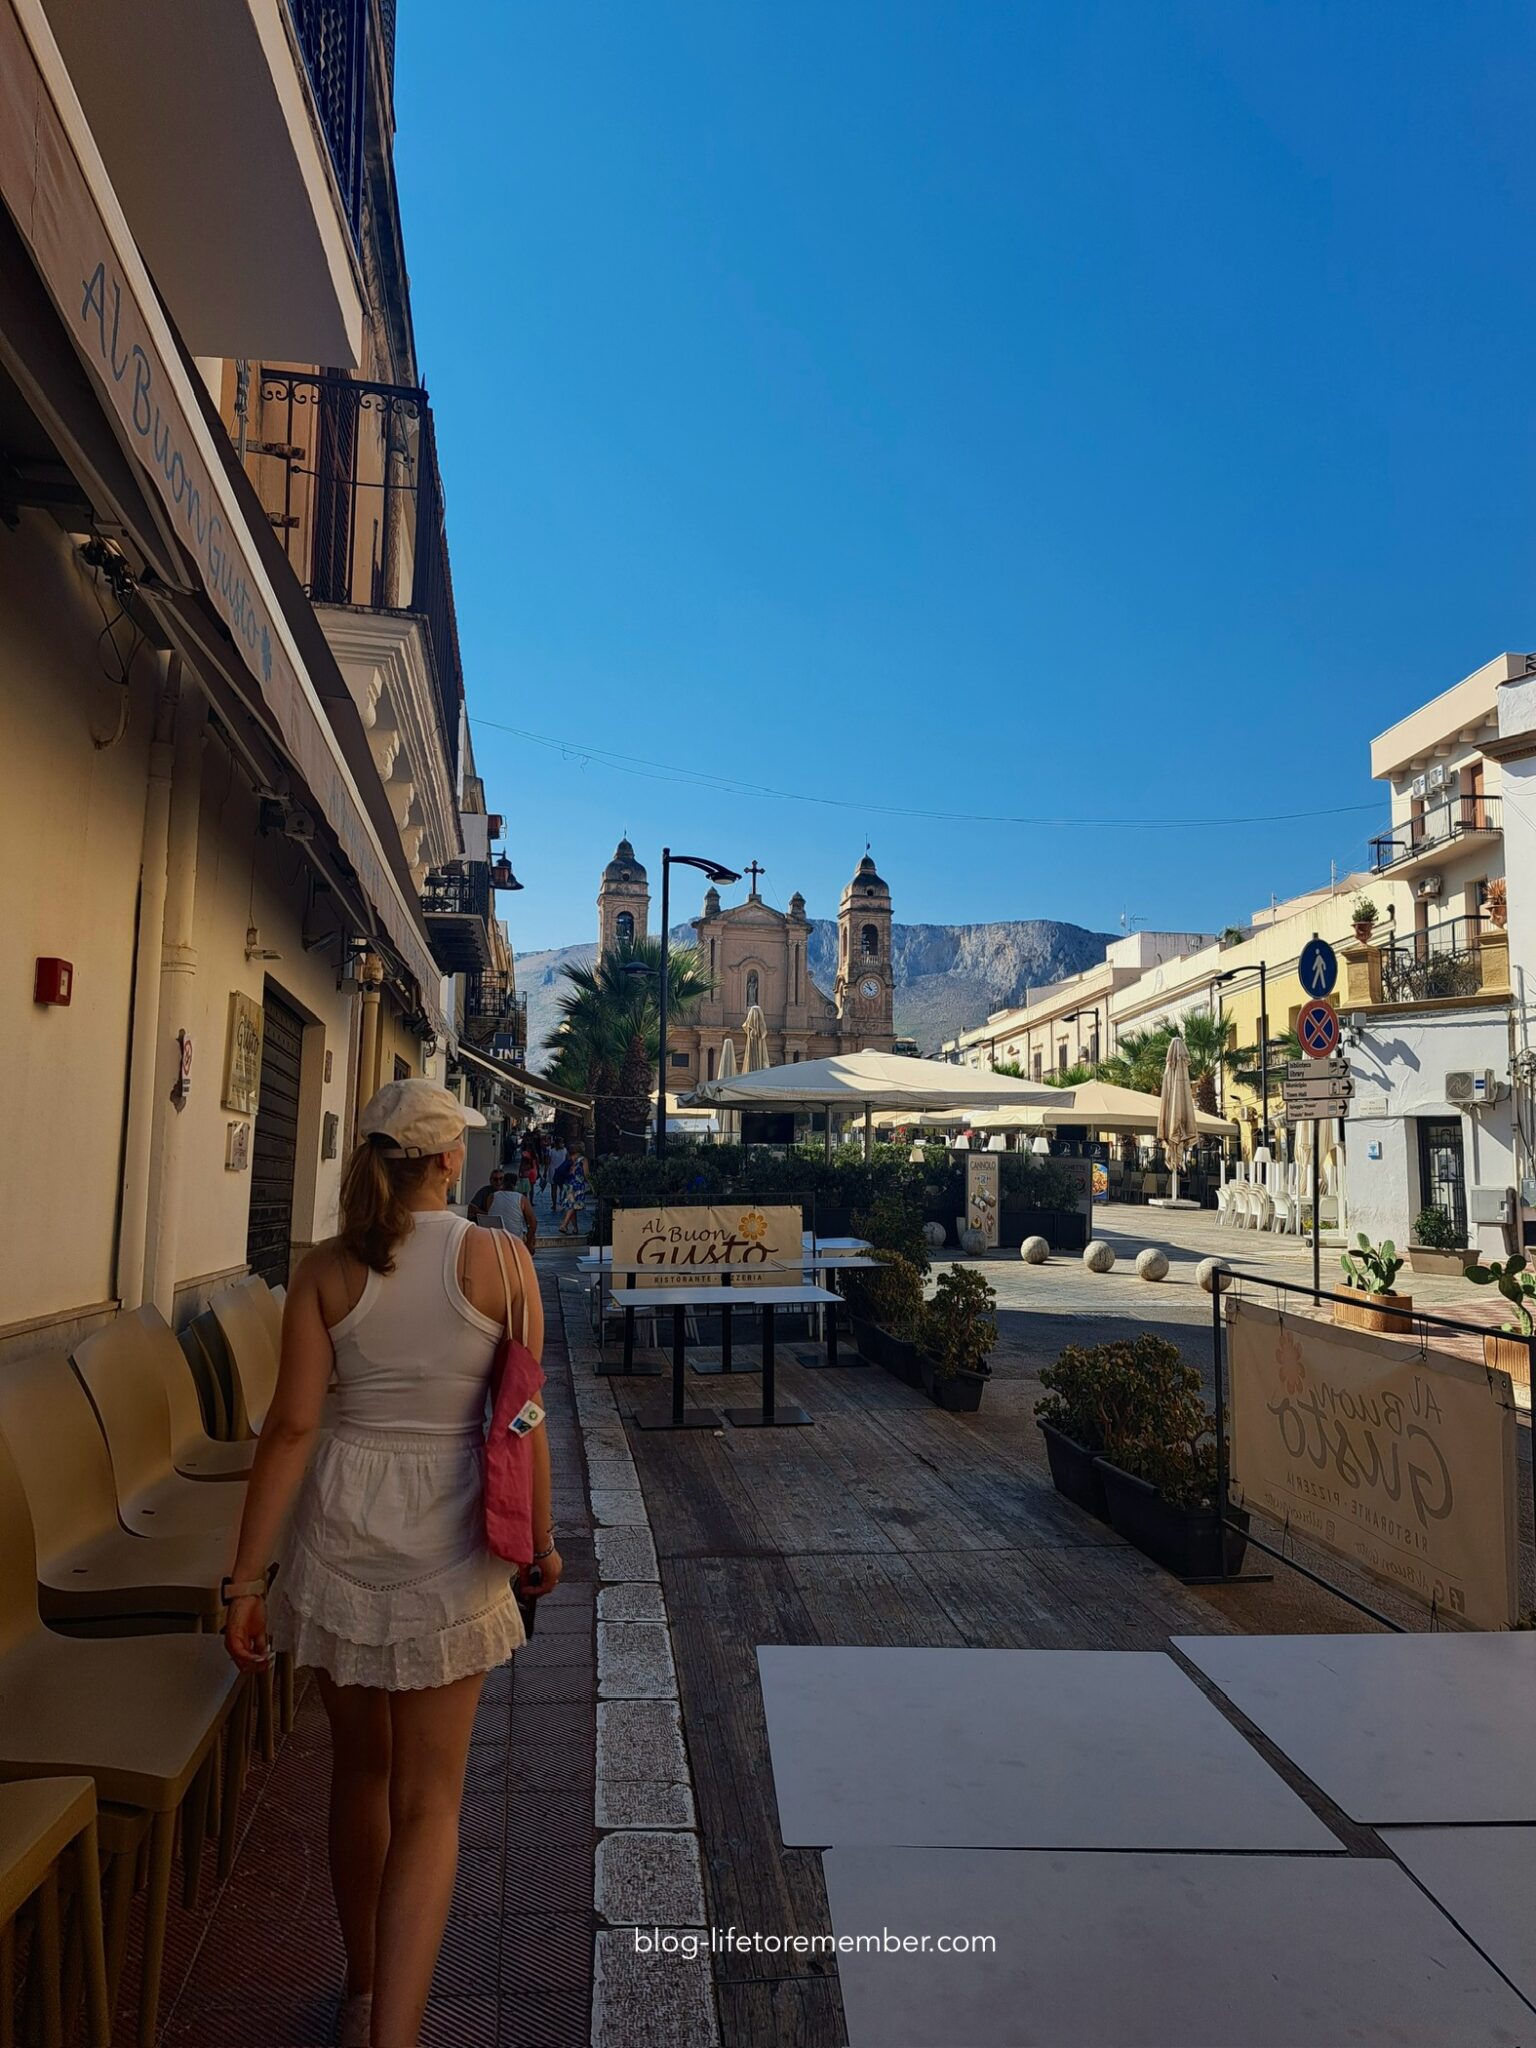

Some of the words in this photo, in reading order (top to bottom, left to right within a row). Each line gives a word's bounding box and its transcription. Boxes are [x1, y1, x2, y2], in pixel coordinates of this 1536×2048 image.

[133, 344, 206, 545] Buon
[208, 516, 260, 649] Gusto
[970, 1160, 996, 1170] CANNOLO
[642, 1218, 665, 1234] Al
[668, 1226, 732, 1242] Buon
[636, 1234, 779, 1265] Gusto
[654, 1275, 712, 1284] RISTORANTE
